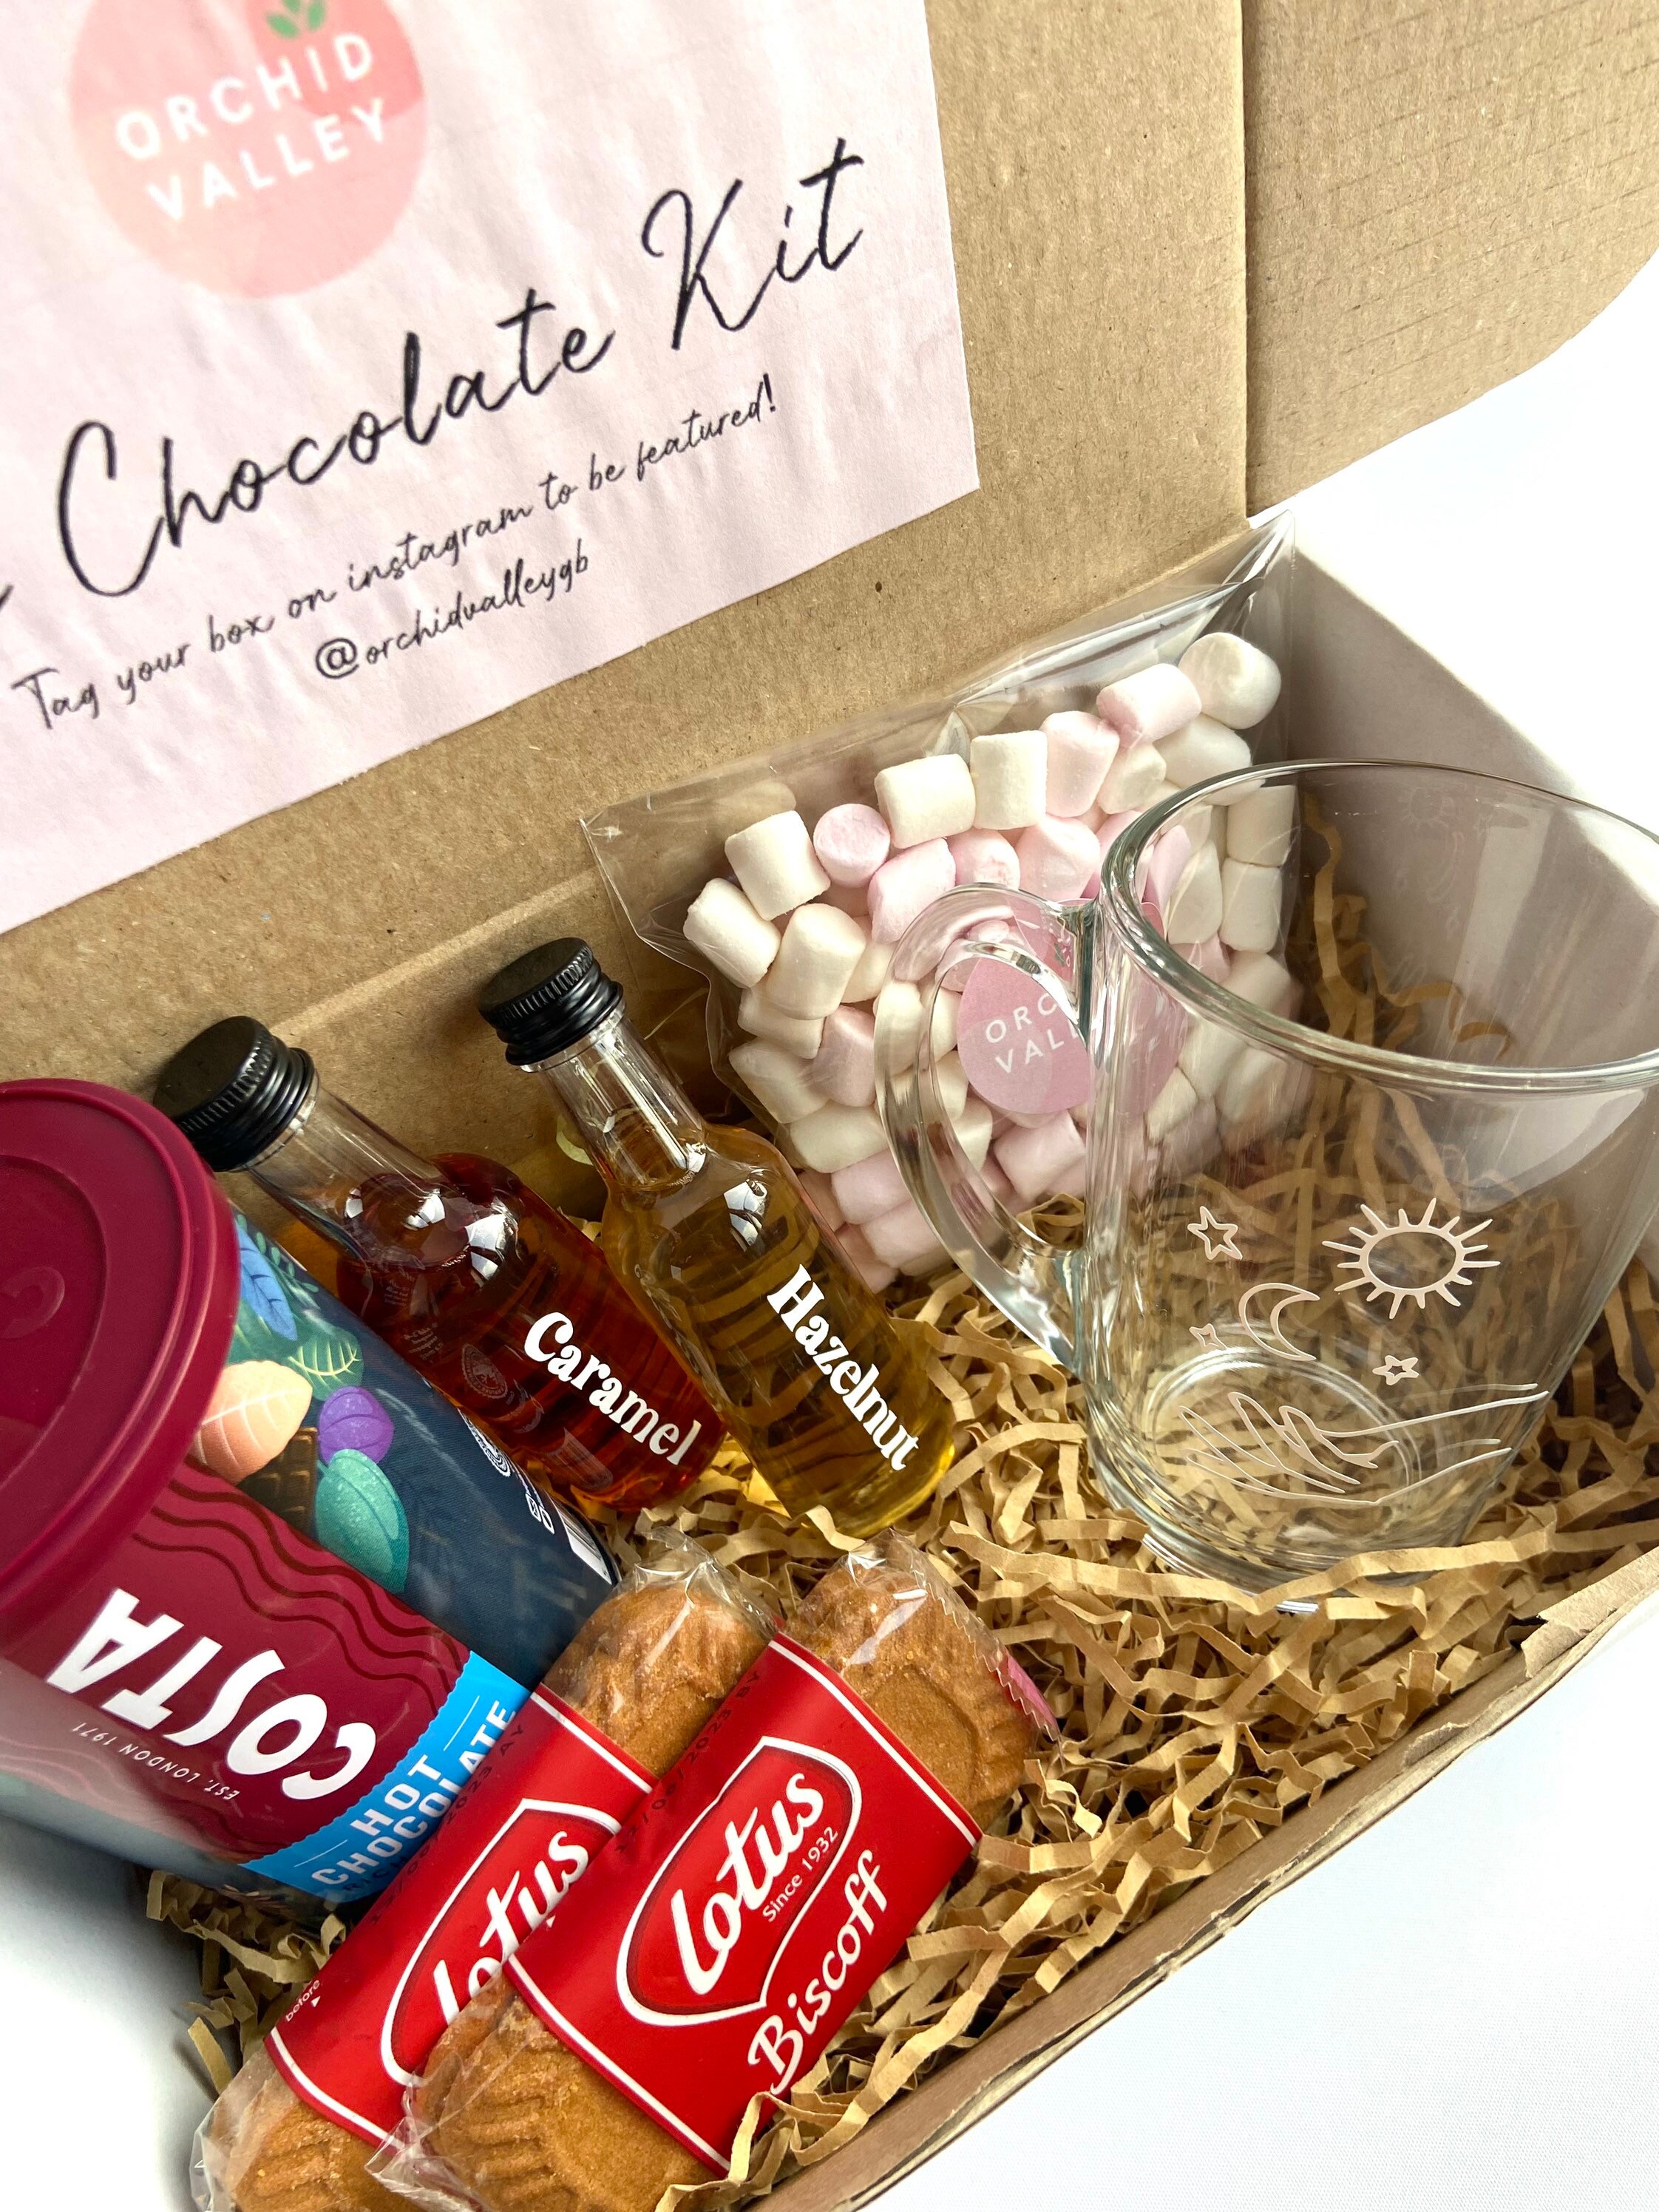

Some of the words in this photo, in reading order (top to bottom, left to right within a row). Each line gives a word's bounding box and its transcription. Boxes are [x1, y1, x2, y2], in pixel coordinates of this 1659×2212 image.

[116, 33, 373, 160] ORCHID
[146, 97, 384, 221] VALLEY
[56, 288, 617, 598] Chocolate
[640, 137, 865, 351] Kit
[10, 667, 101, 730] Tag
[116, 643, 191, 705] your
[208, 614, 276, 654] box
[288, 588, 338, 620] on
[347, 505, 534, 592] instagram
[537, 471, 579, 512] to
[588, 452, 625, 491] be
[637, 372, 776, 481] featured!
[314, 537, 589, 680] @orchidvalleygb
[985, 992, 1058, 1044] ORC
[523, 1311, 702, 1466] Caramel
[766, 1263, 920, 1471] Hazelnut
[46, 1587, 377, 1800] COSTA
[72, 1722, 118, 1746] 1971
[118, 1743, 201, 1783] LONDON
[203, 1779, 241, 1801] EST.
[349, 1754, 442, 1836] HOT
[762, 1872, 804, 1923] Since
[801, 1825, 840, 1871] 1932
[747, 1848, 888, 2096] Biscoff
